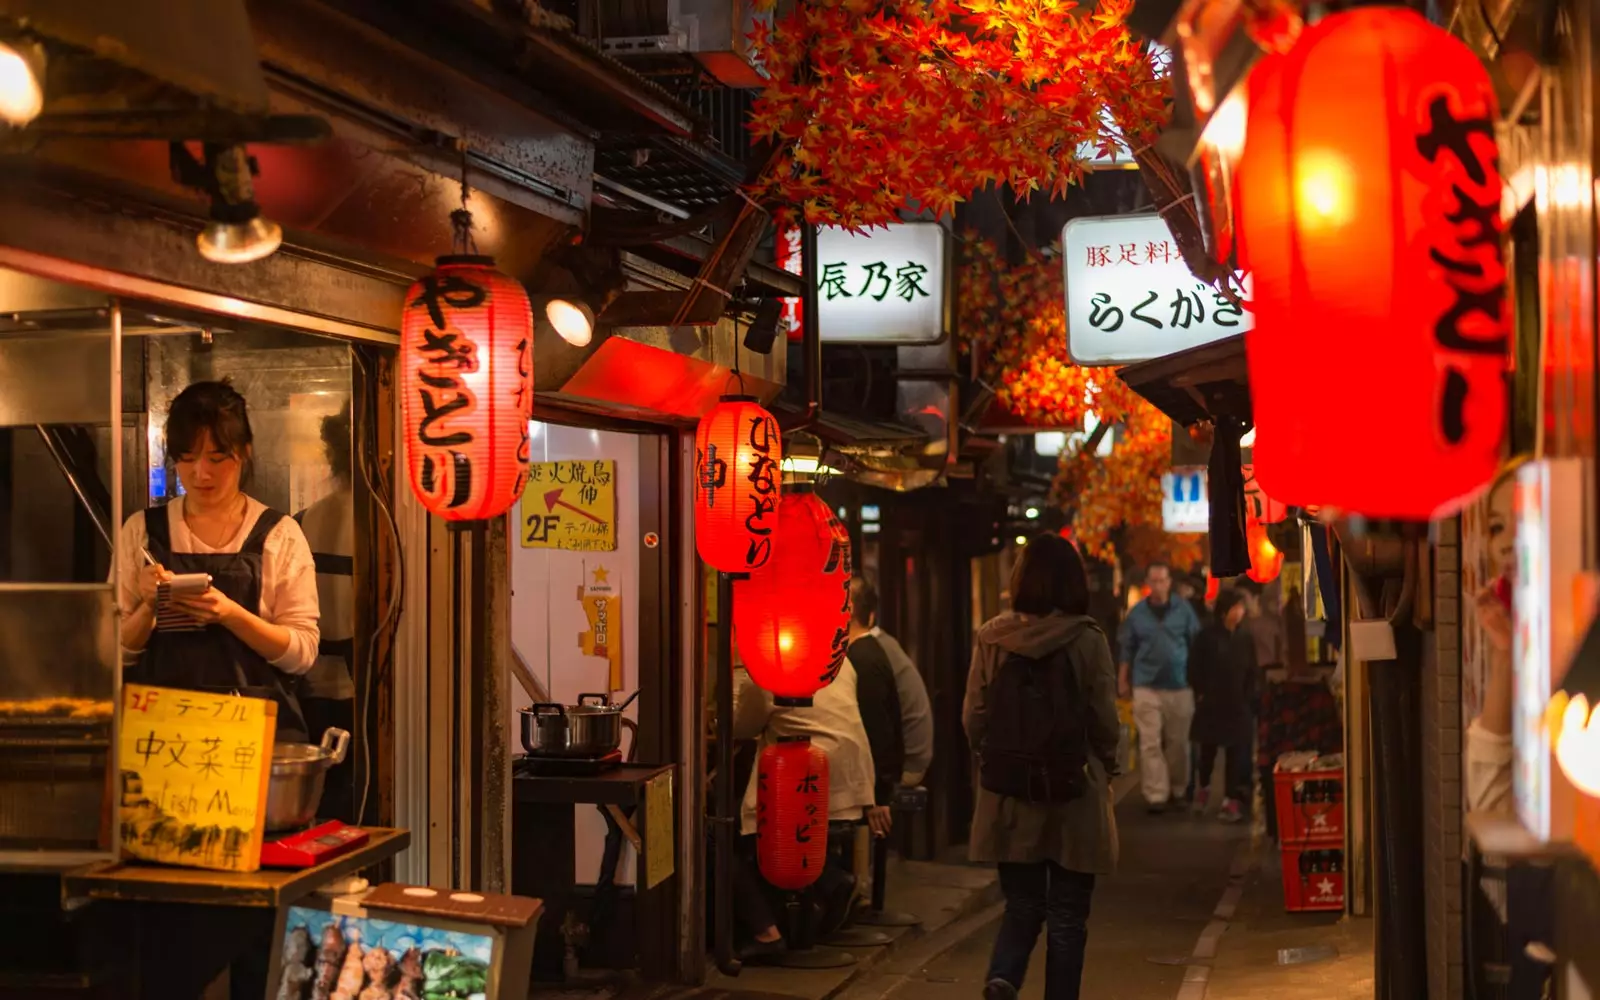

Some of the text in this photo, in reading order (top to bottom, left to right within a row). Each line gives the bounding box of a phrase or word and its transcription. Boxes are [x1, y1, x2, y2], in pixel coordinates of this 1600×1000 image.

[1086, 241, 1186, 267] 豚足料
[818, 261, 931, 303] 辰乃家
[412, 275, 487, 508] やきとり
[744, 416, 779, 569] ひなどり
[527, 514, 560, 542] 2F
[175, 697, 248, 722] テーブル
